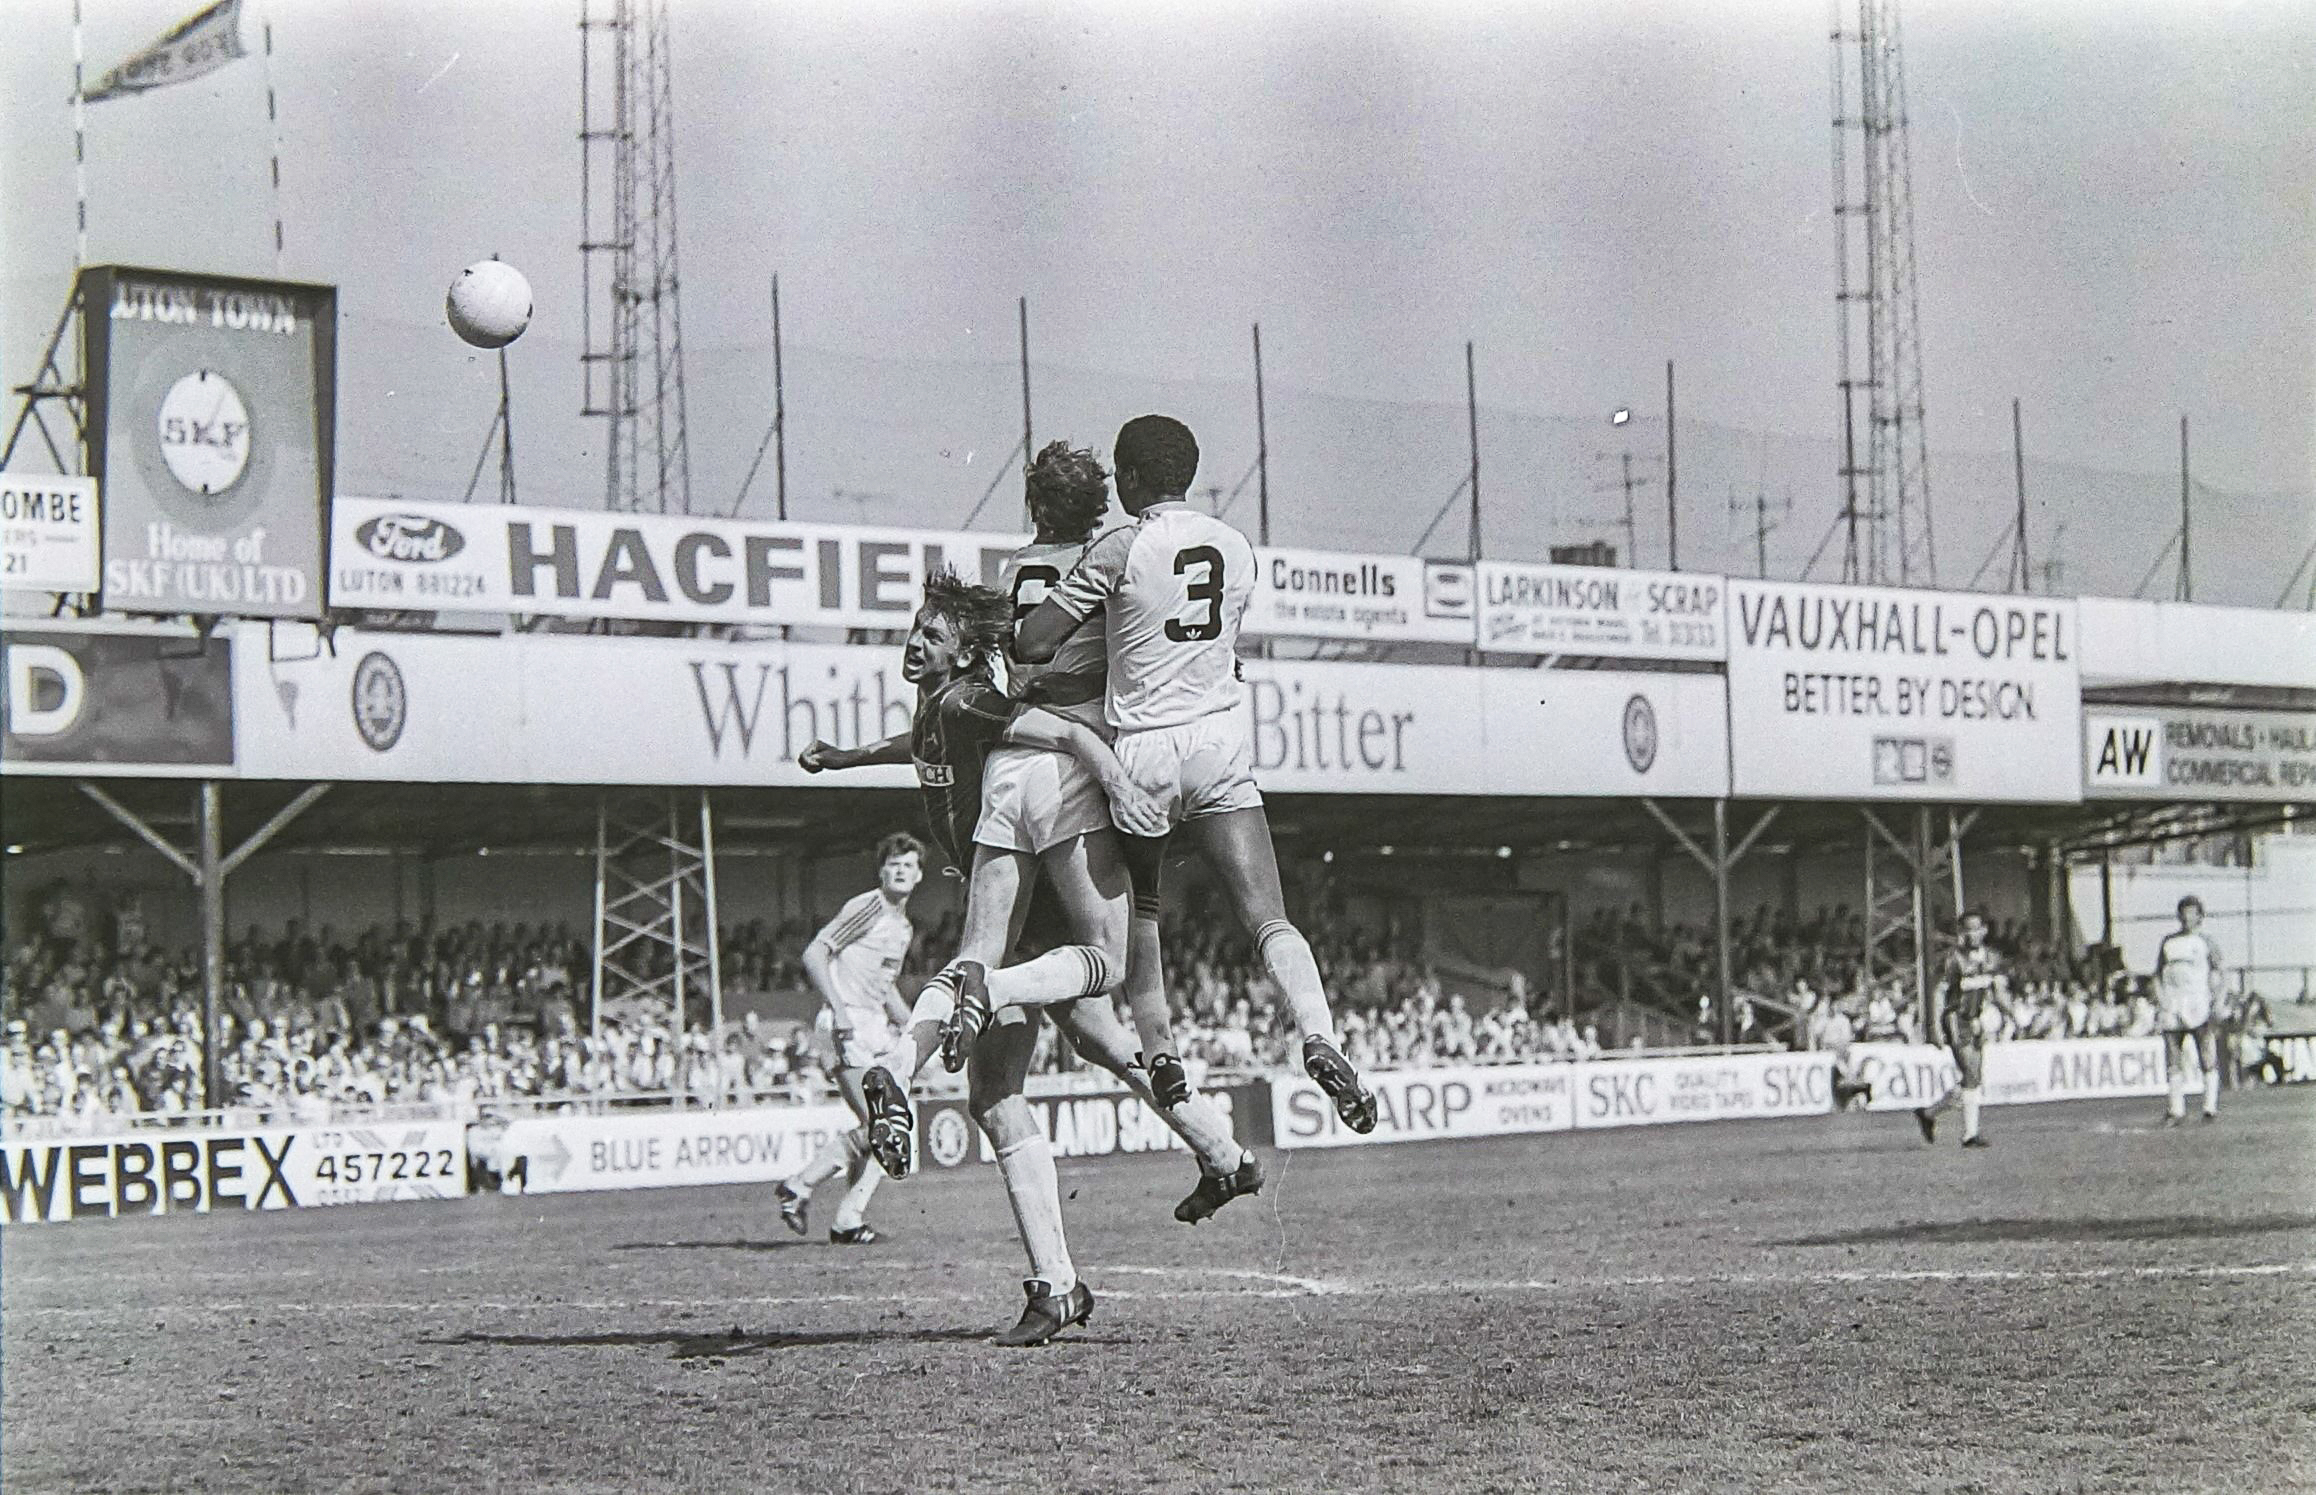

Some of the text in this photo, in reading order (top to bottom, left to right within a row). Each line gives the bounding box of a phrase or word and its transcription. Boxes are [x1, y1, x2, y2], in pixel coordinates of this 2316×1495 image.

[207, 290, 297, 335] TOWN
[164, 417, 246, 449] SKF
[3, 490, 81, 524] OMBE
[149, 521, 267, 564] Home of
[369, 515, 447, 559] Ford
[106, 558, 173, 598] SKF
[243, 566, 307, 605] LTD
[340, 570, 404, 593] LUTON
[1165, 545, 1225, 642] 3
[1272, 558, 1395, 597] Connells
[1487, 575, 1718, 616] LARKINSON SCRAP
[1740, 594, 2068, 662] VAUXHALL-OPEL
[1784, 672, 1890, 714] BETTER
[1899, 677, 1930, 716] BY
[1250, 677, 1414, 773] Bitter
[2165, 720, 2253, 751] REMOVALS
[2096, 727, 2152, 776] AW
[2167, 757, 2273, 787] COMMERCIAL
[1589, 1073, 1655, 1118] SKC
[1763, 1064, 1829, 1108] SKC
[1288, 1081, 1472, 1137] SARP
[316, 1149, 454, 1184] 457222
[591, 1139, 660, 1173] BLUE
[675, 1133, 786, 1167] ARROW
[0, 1134, 300, 1224] WEBBEX
